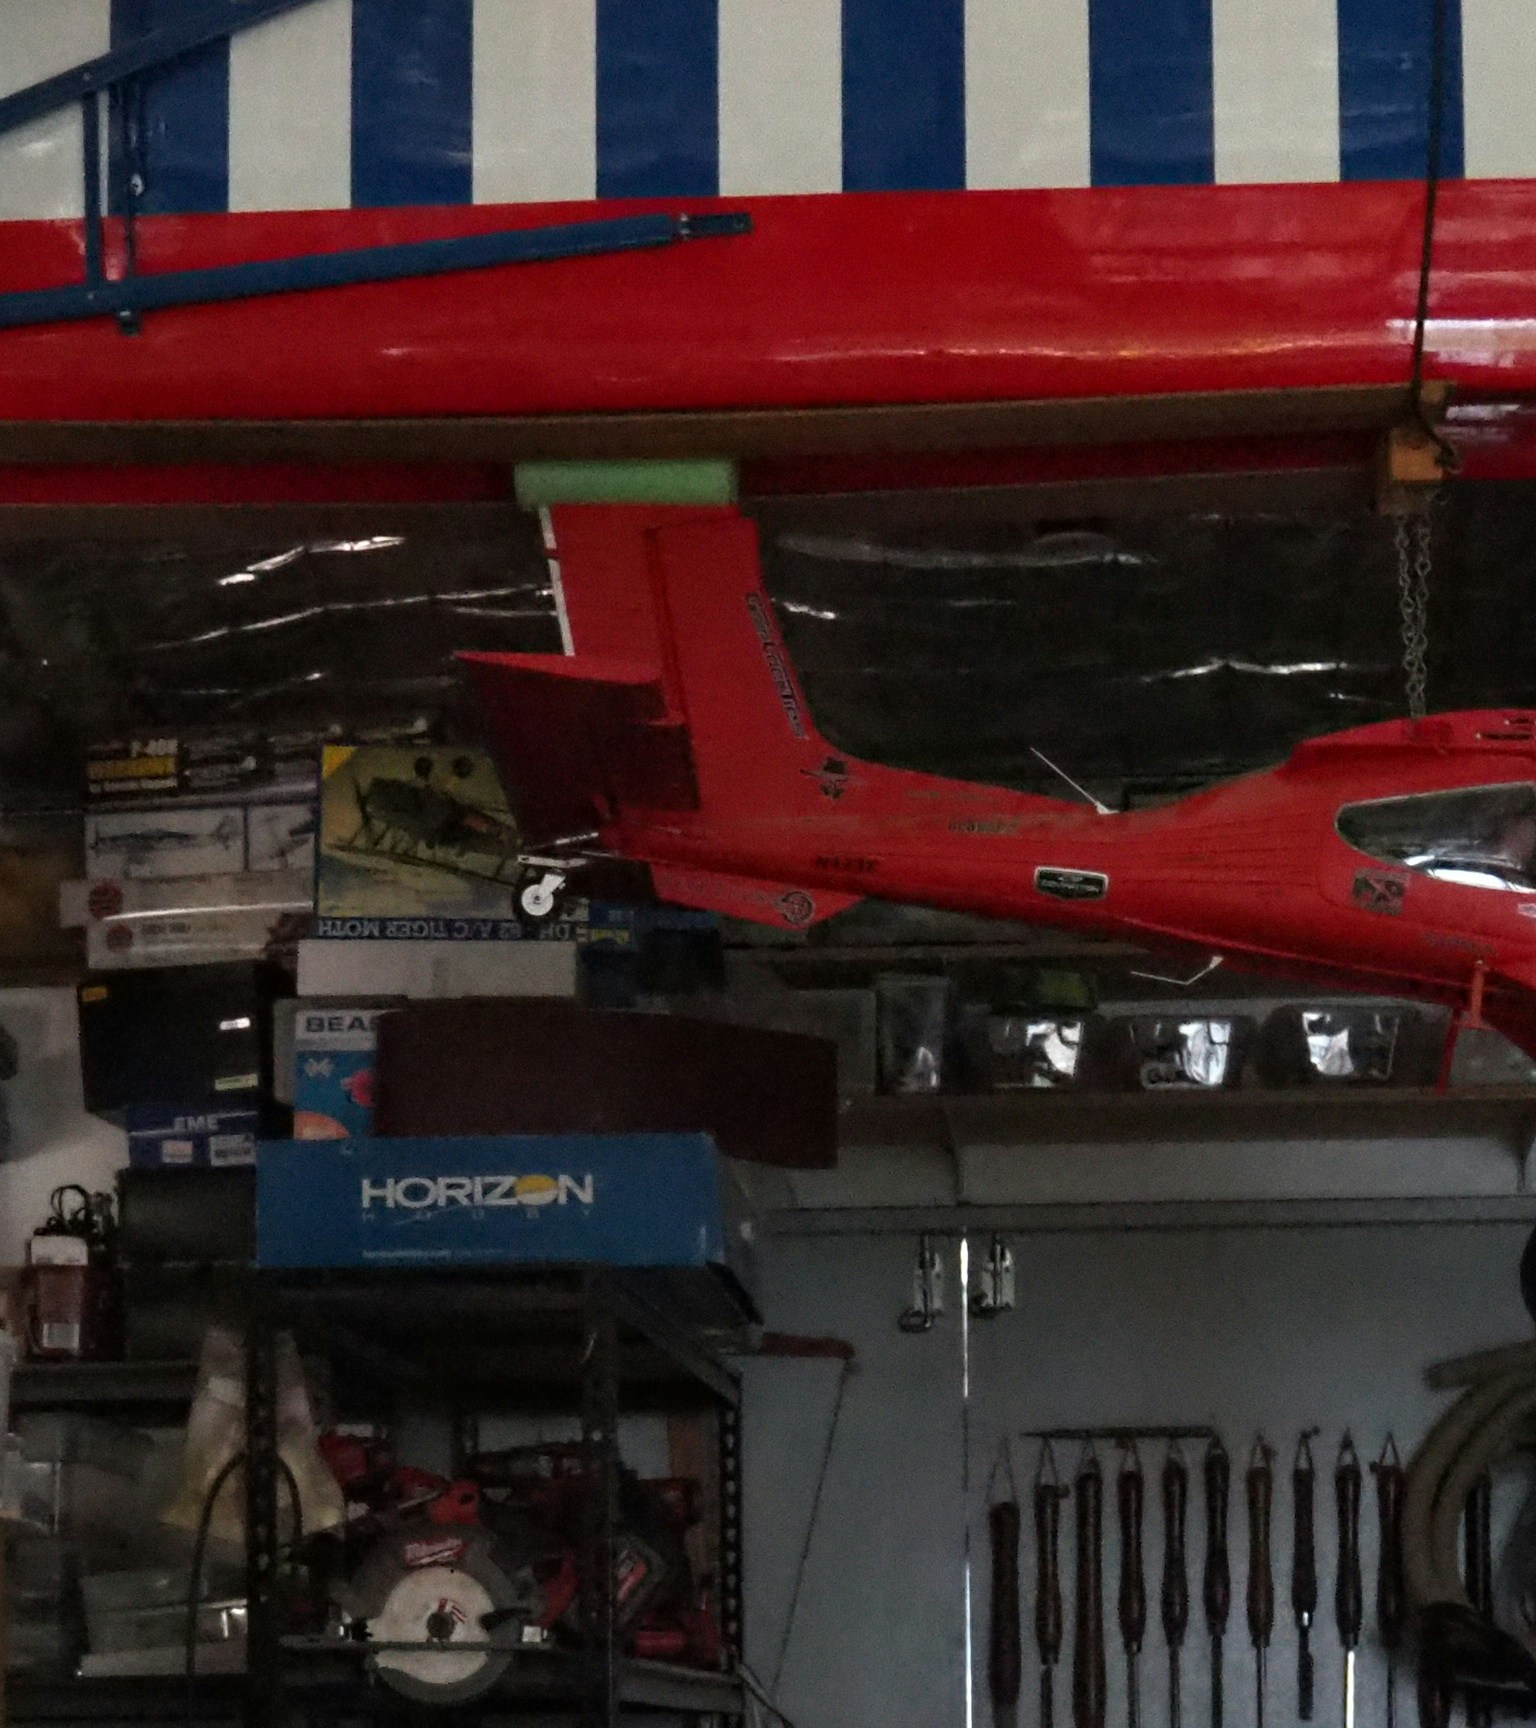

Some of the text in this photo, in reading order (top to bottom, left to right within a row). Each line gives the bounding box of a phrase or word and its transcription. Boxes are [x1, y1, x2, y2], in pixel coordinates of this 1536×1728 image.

[317, 918, 381, 939] MOTH
[386, 919, 447, 939] TIGER
[362, 1173, 594, 1209] HORIZON
